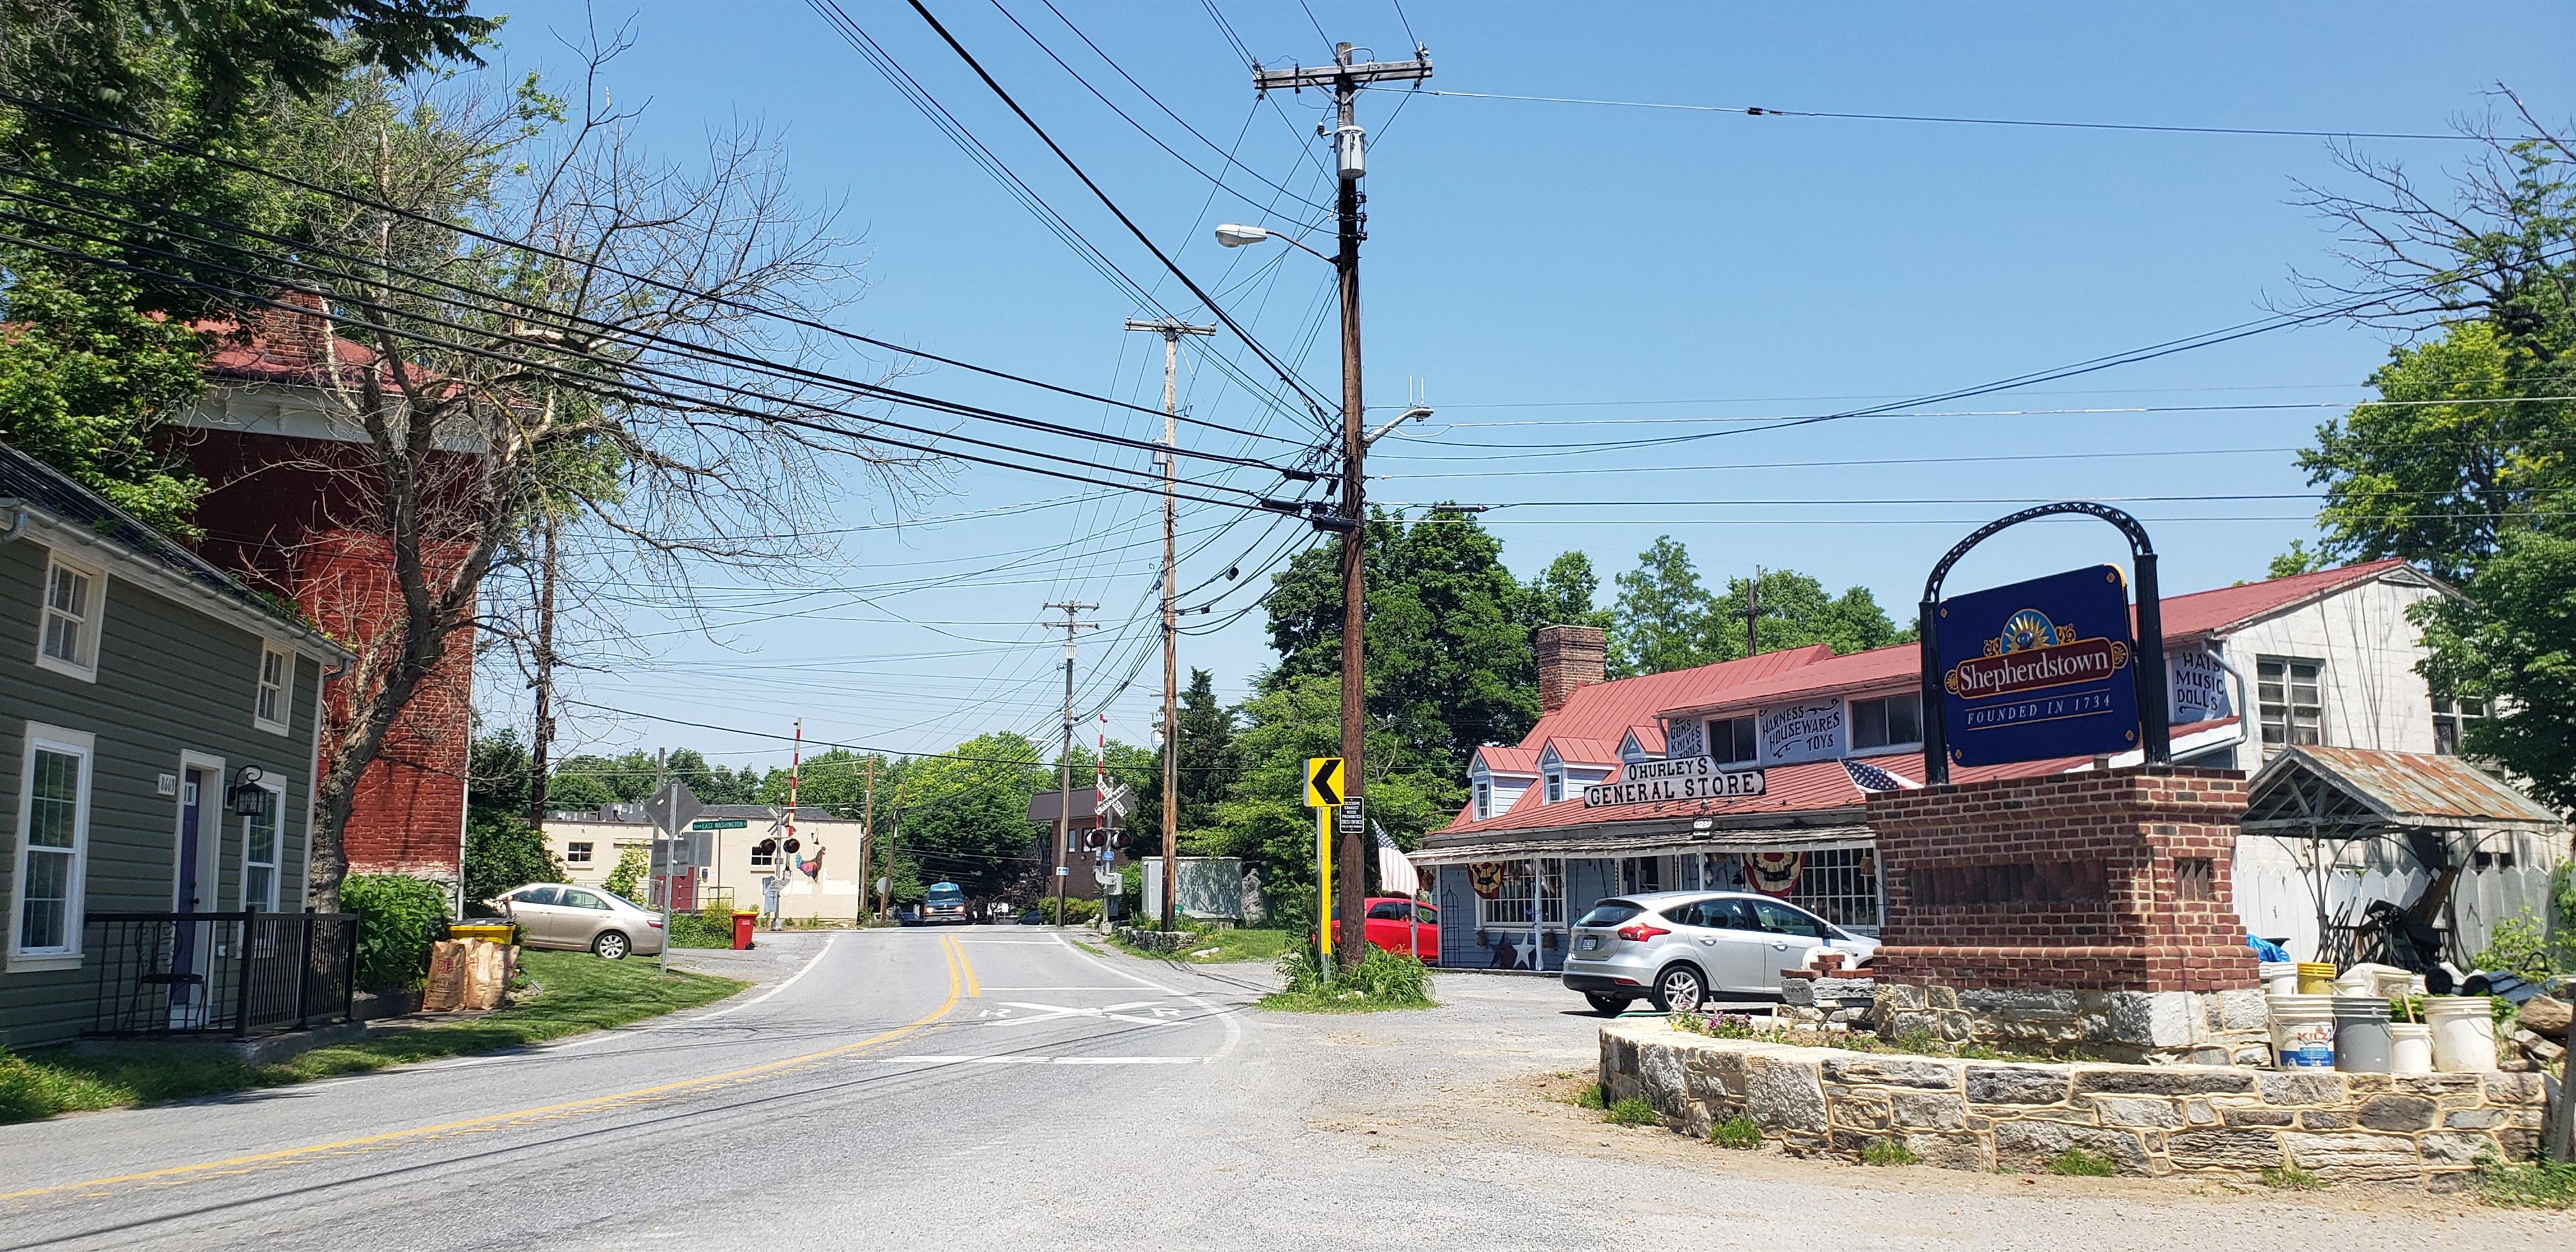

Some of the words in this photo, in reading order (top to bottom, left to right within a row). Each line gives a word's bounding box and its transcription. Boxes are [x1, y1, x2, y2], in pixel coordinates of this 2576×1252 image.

[1960, 651, 2108, 691] Shepherdstown
[2182, 652, 2220, 672] HATS
[2176, 670, 2224, 695] MUSIC
[1967, 704, 2037, 725] FOUNDED
[2047, 700, 2064, 715] IN
[2074, 694, 2110, 711] 1734
[2177, 688, 2218, 711] DOLLS
[1671, 720, 1691, 740] GUNS
[1762, 706, 1804, 742] HARNESS
[1769, 712, 1840, 752] HOUSEWARES
[1671, 725, 1701, 752] KNIVES
[1807, 734, 1834, 752] TOYS
[1629, 757, 1707, 781] O'HURLEY'S
[1095, 784, 1128, 813] CROSSING
[1591, 781, 1675, 805] GENERAL
[1684, 773, 1754, 797] STORE
